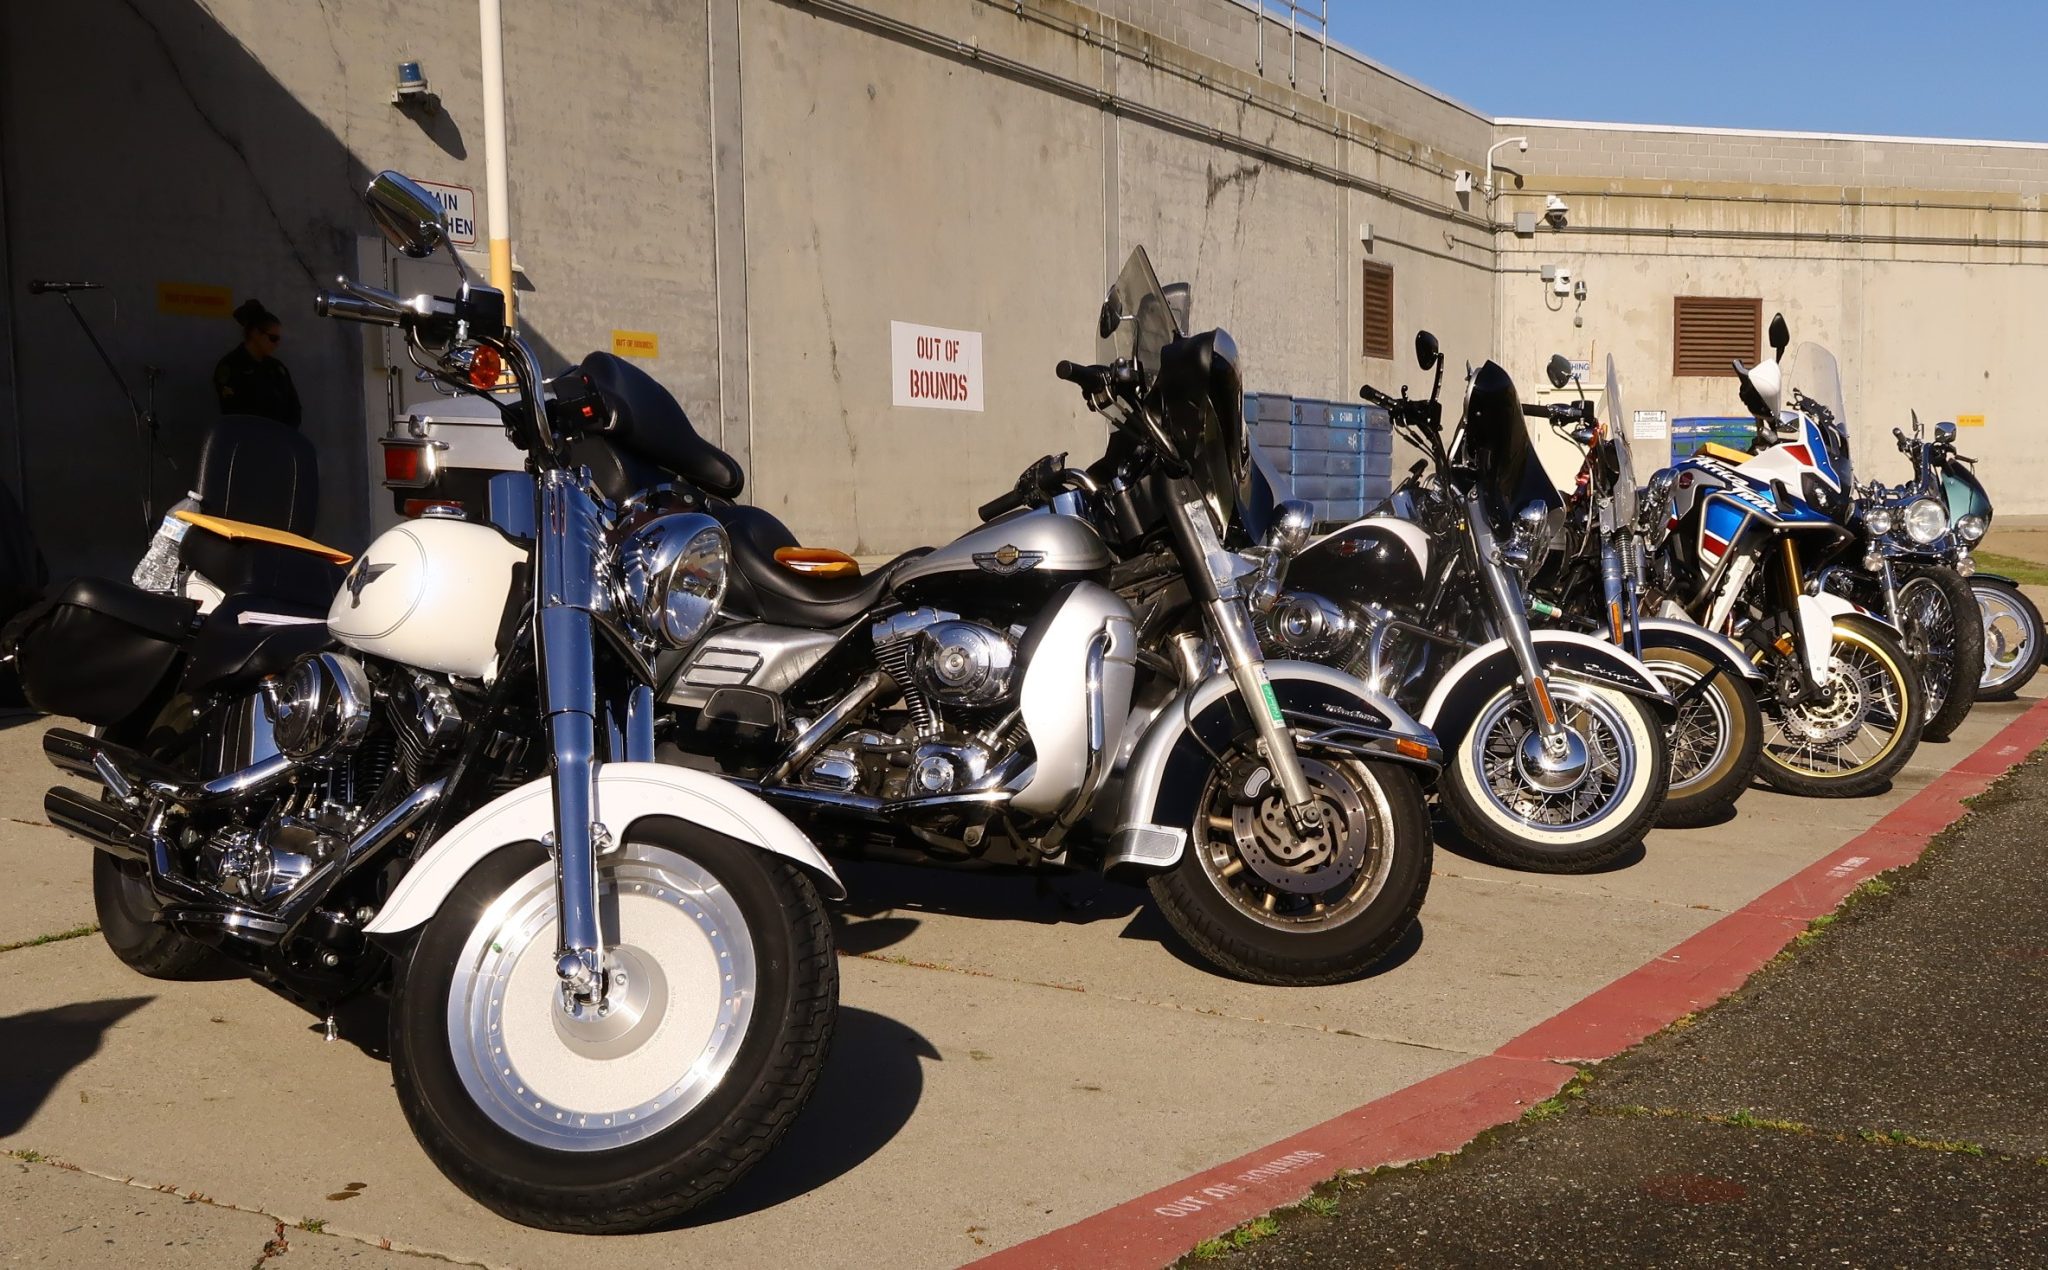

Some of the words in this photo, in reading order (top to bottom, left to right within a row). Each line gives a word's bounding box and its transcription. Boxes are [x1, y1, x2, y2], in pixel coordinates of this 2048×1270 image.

[429, 191, 458, 211] AIN
[917, 335, 941, 361] OUT
[945, 339, 960, 363] OF
[910, 369, 968, 401] BOUNDS
[1682, 454, 1749, 489] Africa
[1717, 484, 1784, 521] Twin
[1154, 1195, 1213, 1217] OUT
